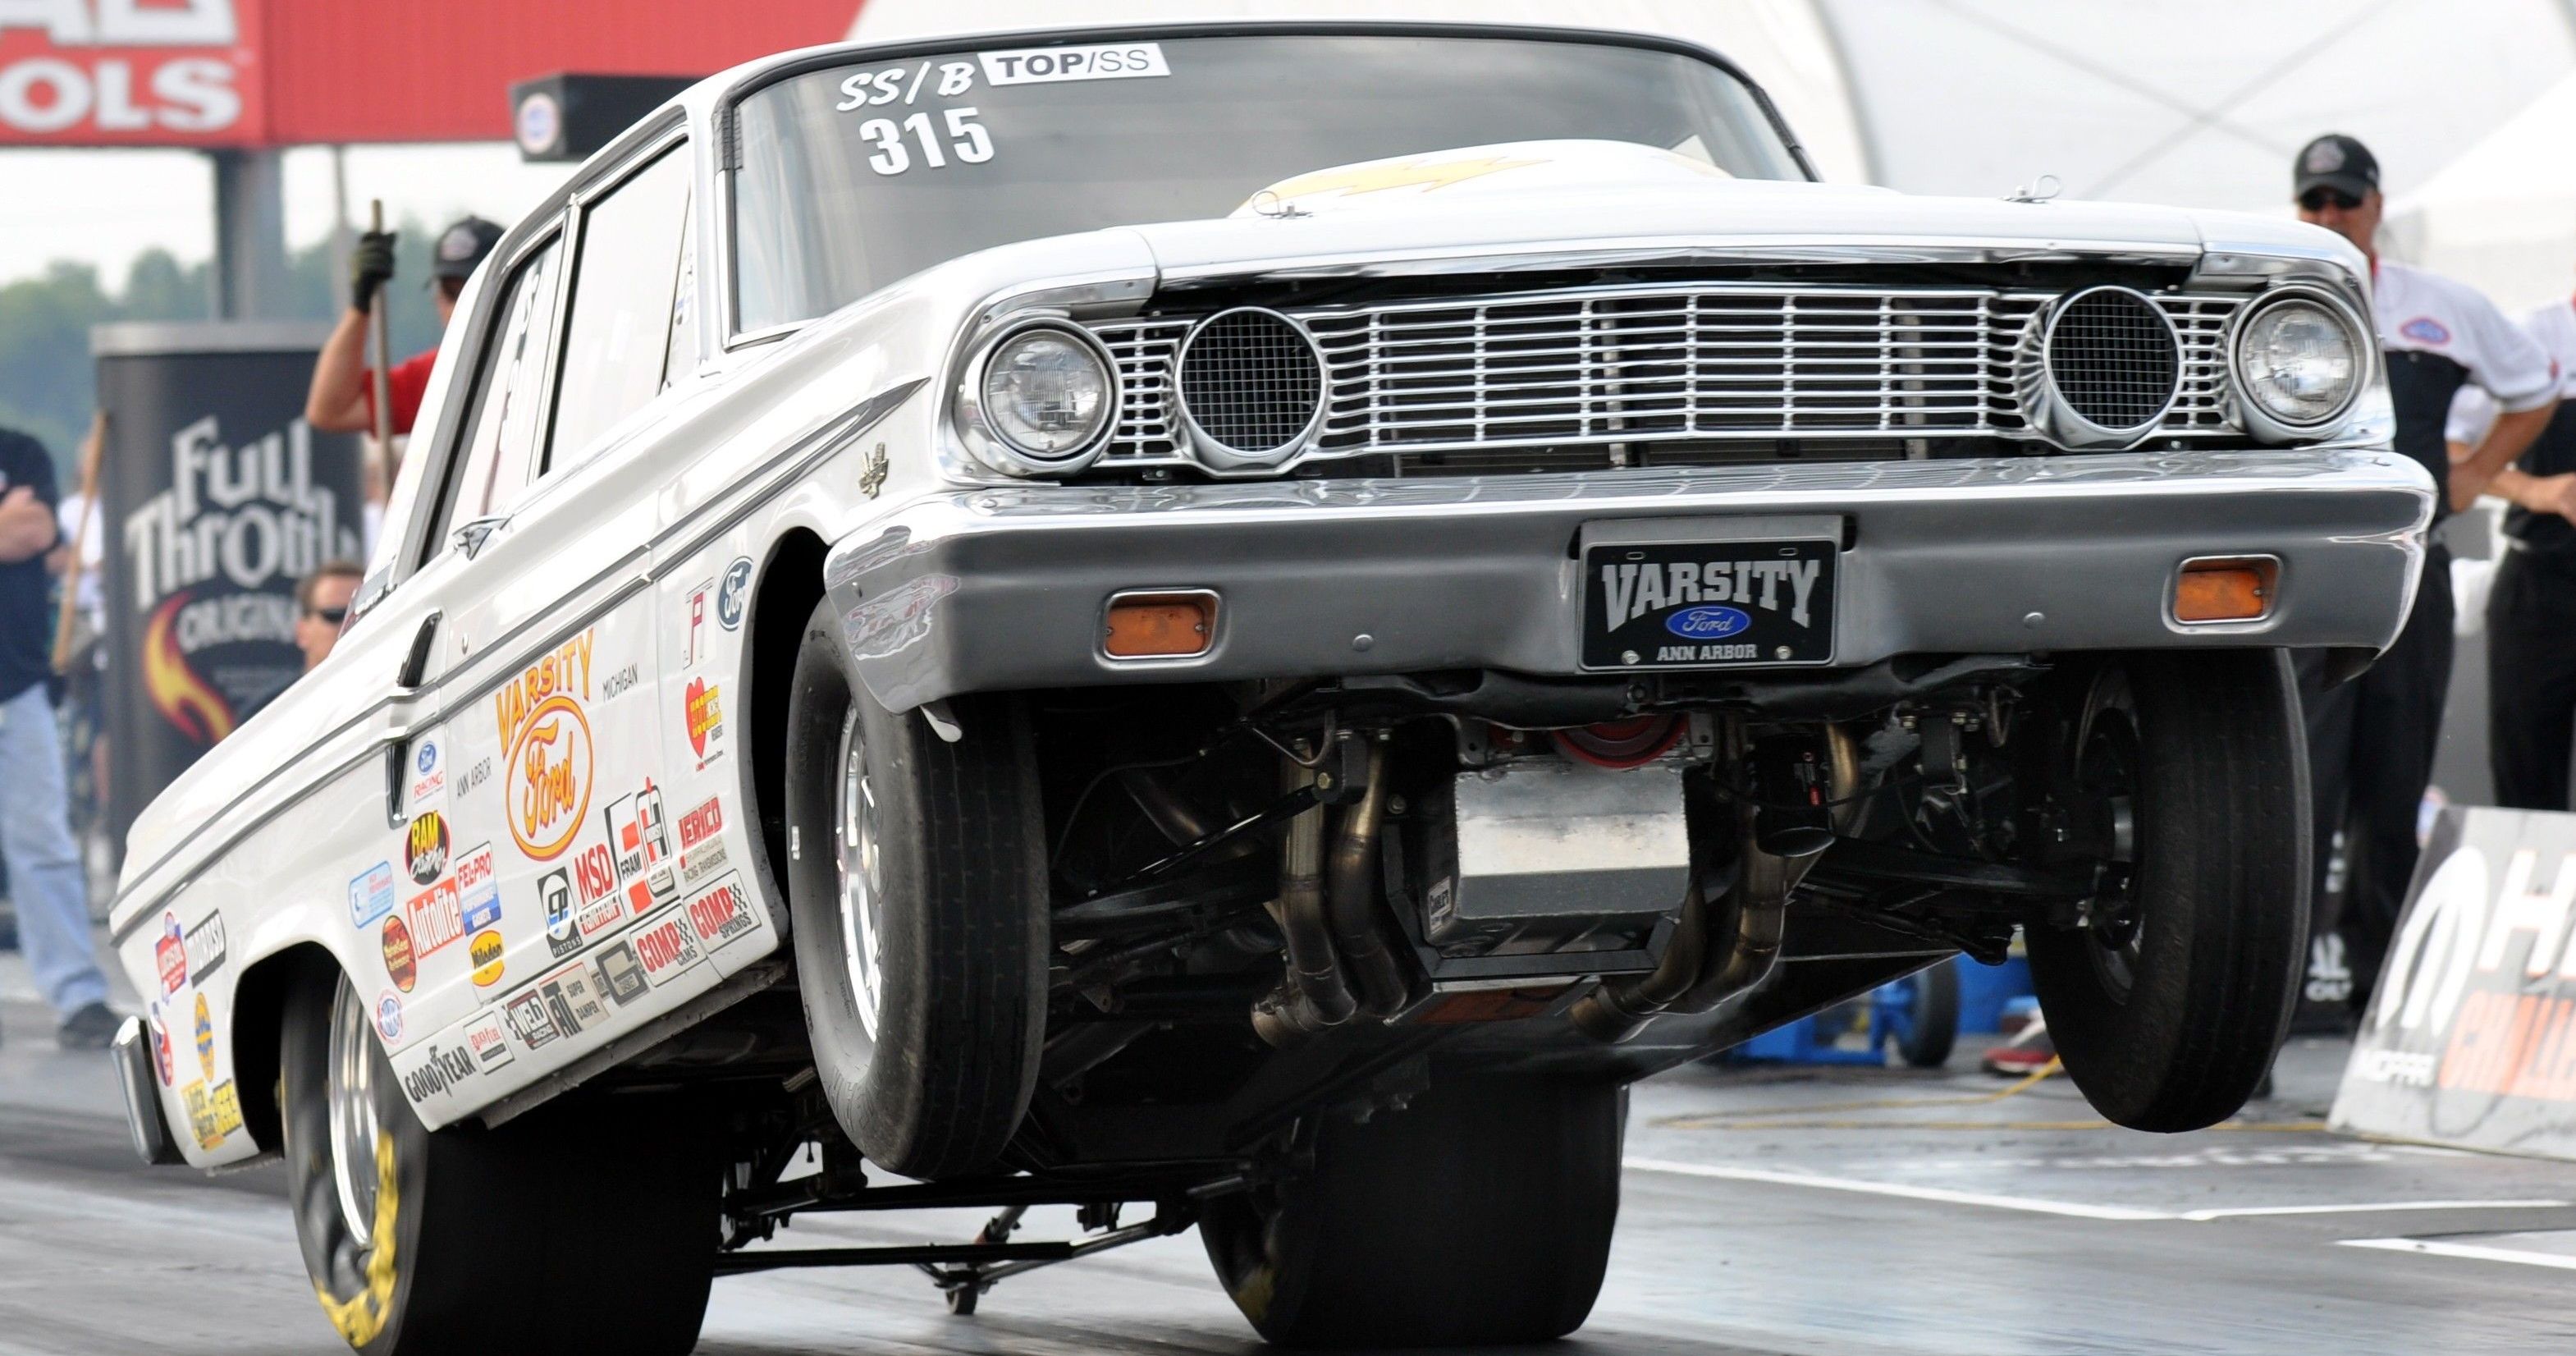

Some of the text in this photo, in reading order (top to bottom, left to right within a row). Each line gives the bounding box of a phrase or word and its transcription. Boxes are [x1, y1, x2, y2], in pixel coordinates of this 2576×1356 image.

[836, 61, 976, 112] SS/B
[995, 49, 1150, 79] TOP/SS
[858, 107, 995, 176] 315
[172, 414, 313, 522] Full
[1602, 559, 1821, 634] VARSITY
[1681, 610, 1734, 633] Ford
[1656, 644, 1758, 662] ANN ARBOR
[495, 627, 595, 762] VARSITY
[602, 662, 638, 703] MICHIGAN
[523, 717, 576, 840] Ford
[411, 809, 440, 860] RAM
[679, 796, 723, 850] JERICO
[574, 843, 614, 905] MSD
[620, 851, 643, 881] FRAM
[409, 886, 461, 959] Autolite
[689, 886, 734, 940] COMP
[718, 911, 753, 939] SPRINGS
[551, 936, 583, 959] PISTONS
[636, 922, 681, 973] COMP
[675, 945, 698, 967] CAMS
[405, 1044, 476, 1103] GOODYEAR
